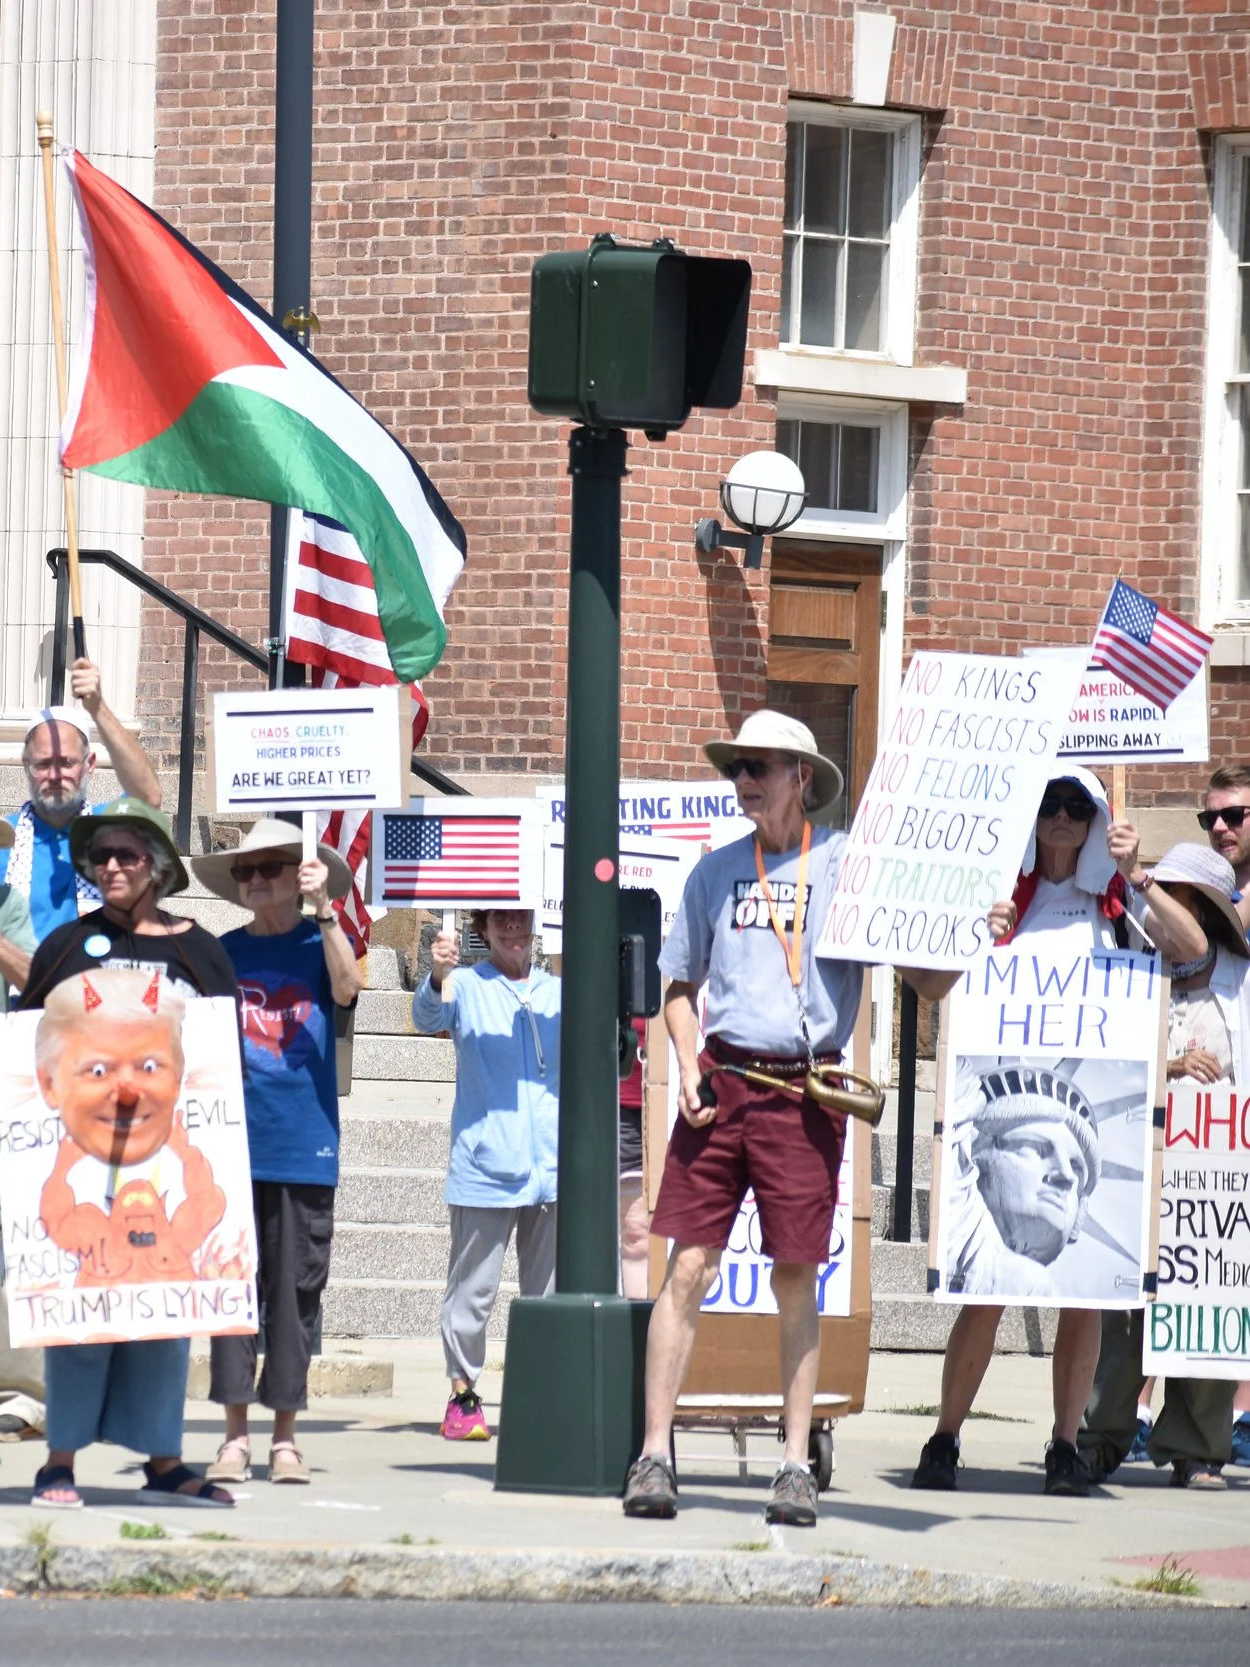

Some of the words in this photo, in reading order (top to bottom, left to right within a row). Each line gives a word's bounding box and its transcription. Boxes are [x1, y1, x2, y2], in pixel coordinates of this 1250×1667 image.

[905, 659, 942, 697] NO
[954, 664, 1042, 703] KINGS
[1078, 682, 1138, 698] AMERIC
[887, 706, 925, 747] NO
[928, 709, 1052, 755] FASCISTS
[1068, 708, 1090, 723] OW
[1093, 709, 1106, 722] IS
[1109, 707, 1167, 723] RAPIDLY
[256, 746, 297, 760] HIGHER
[1122, 732, 1161, 747] AWAY
[232, 772, 261, 788] ARE
[263, 771, 284, 787] WE
[288, 770, 335, 786] GREAT
[337, 769, 371, 785] YET?
[869, 750, 910, 795] NO
[914, 757, 1016, 803] FELONS
[851, 799, 894, 845] NO
[894, 805, 1003, 856] BIGOTS
[632, 866, 653, 878] RED
[833, 853, 871, 896] NO
[872, 857, 1002, 909] TRAITORS
[823, 903, 860, 946] NO
[866, 906, 987, 957] CROOKS
[1031, 955, 1156, 1000] WITH
[997, 1002, 1109, 1049] HER
[185, 1098, 241, 1129] EVIL
[1160, 1168, 1207, 1192] WHEN
[1211, 1168, 1249, 1192] THEY
[10, 1216, 50, 1244] NO
[4, 1238, 111, 1281] FASCISM!
[14, 1288, 124, 1330] TRUMP
[130, 1289, 155, 1322] IS
[162, 1282, 253, 1321] LYING!
